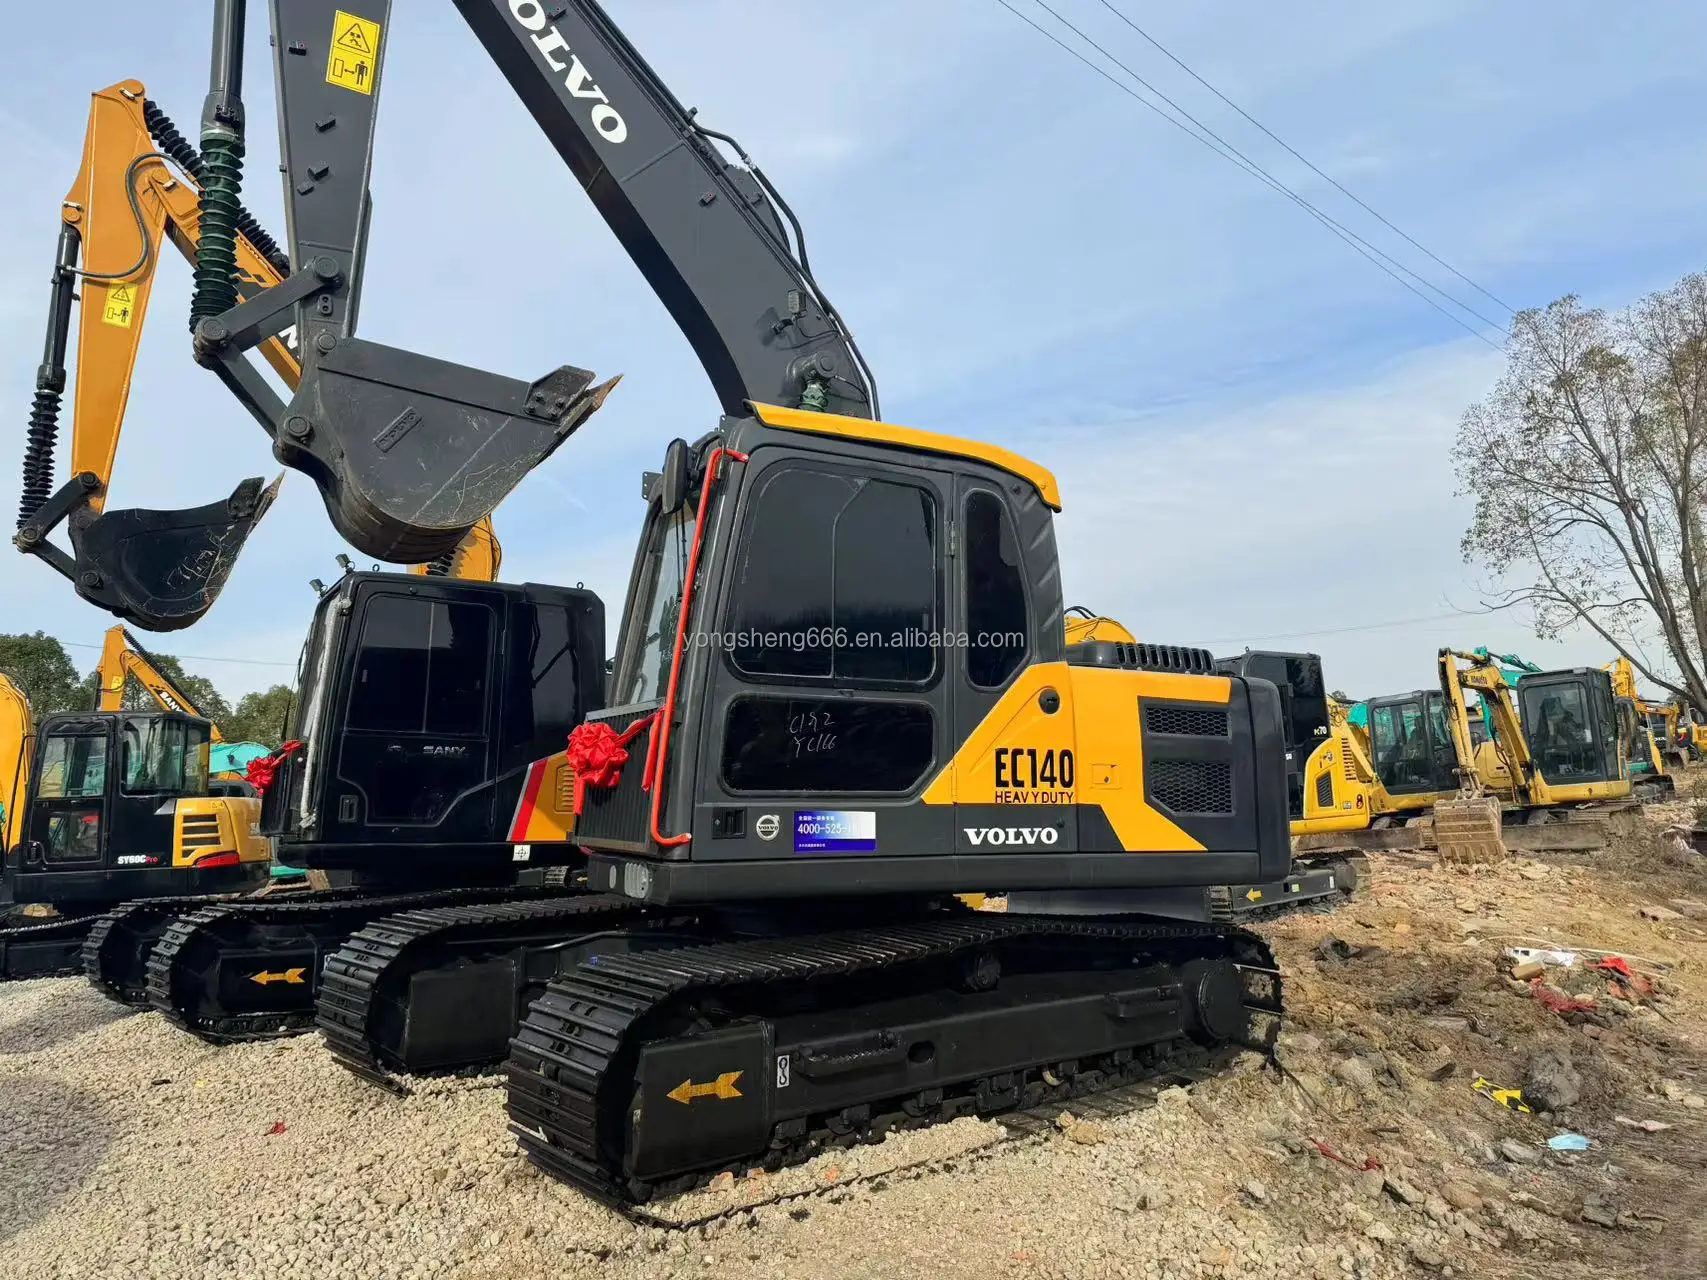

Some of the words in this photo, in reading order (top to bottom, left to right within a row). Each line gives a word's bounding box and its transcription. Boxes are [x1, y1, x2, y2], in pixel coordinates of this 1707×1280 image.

[422, 745, 466, 759] SANY
[994, 747, 1075, 789] EC140
[963, 826, 1059, 846] VOLVO
